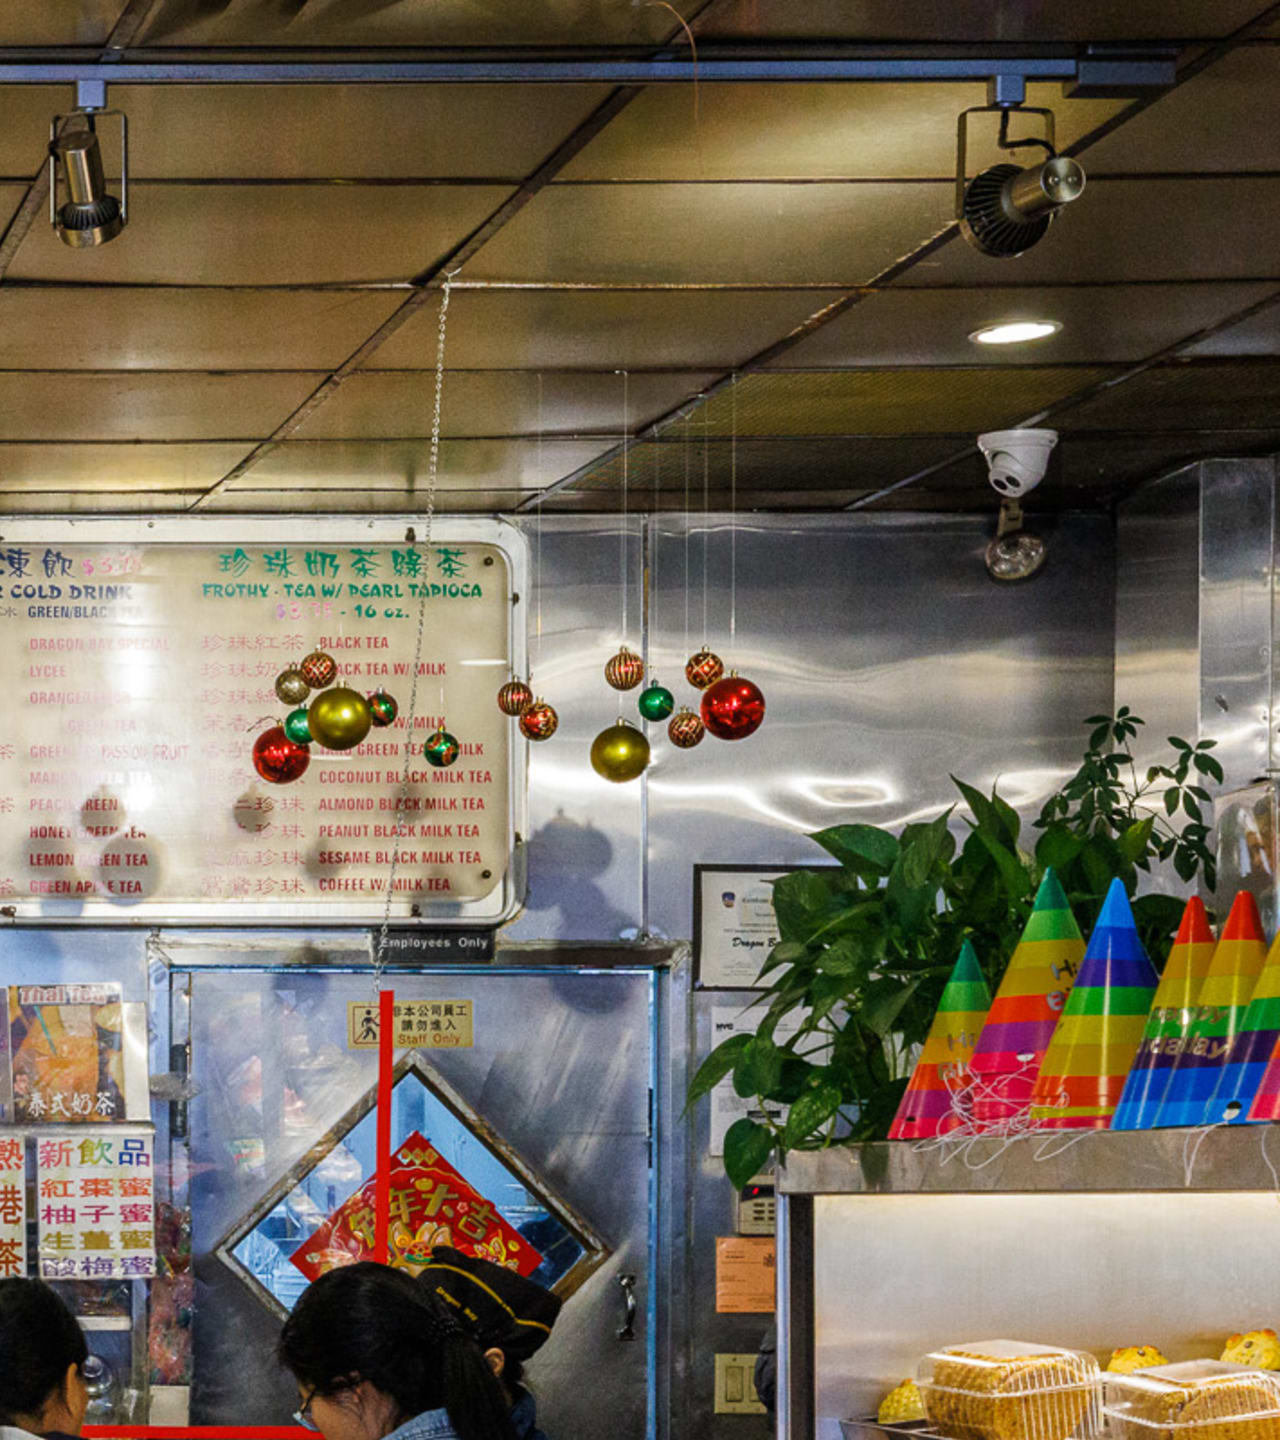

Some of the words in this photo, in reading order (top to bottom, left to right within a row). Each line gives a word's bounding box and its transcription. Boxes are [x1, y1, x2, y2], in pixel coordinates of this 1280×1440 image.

[10, 583, 62, 599] COLD
[69, 583, 133, 599] DRINK
[202, 583, 269, 598] FROTHY
[283, 583, 315, 598] TEA
[348, 583, 404, 598] PEARL
[408, 583, 483, 598] TAPIOCA
[30, 638, 84, 651] DRAGON
[320, 636, 361, 649] BLACK
[366, 636, 389, 649] TEA
[366, 662, 388, 675] TEA
[421, 716, 446, 729] MILK
[357, 743, 398, 757] GREEN
[320, 771, 381, 784] COCONUT
[432, 771, 464, 784] MILK
[469, 771, 492, 784] TEA
[318, 798, 375, 810] ALMOND
[425, 798, 458, 810] MILK
[462, 798, 485, 810] TEA
[319, 825, 370, 838] PEANUT
[420, 825, 452, 838] MILK
[456, 825, 480, 838] TEA
[29, 853, 74, 866] LEMON
[125, 853, 148, 866] TEA
[318, 851, 370, 864] SESAME
[422, 851, 454, 864] MILK
[458, 851, 481, 864] TEA
[30, 879, 72, 893] GREEN
[120, 879, 142, 893] TEA
[319, 878, 364, 891] COFFEE
[392, 878, 423, 891] MILK
[427, 878, 450, 891] TEA
[380, 938, 450, 949] Employees
[458, 937, 488, 949] Only
[398, 1034, 426, 1045] Staff
[433, 1033, 460, 1044] Only
[28, 1092, 116, 1117] 泰式奶茶
[40, 1138, 150, 1168] 新飲品
[41, 1204, 152, 1224] 柚子蜜
